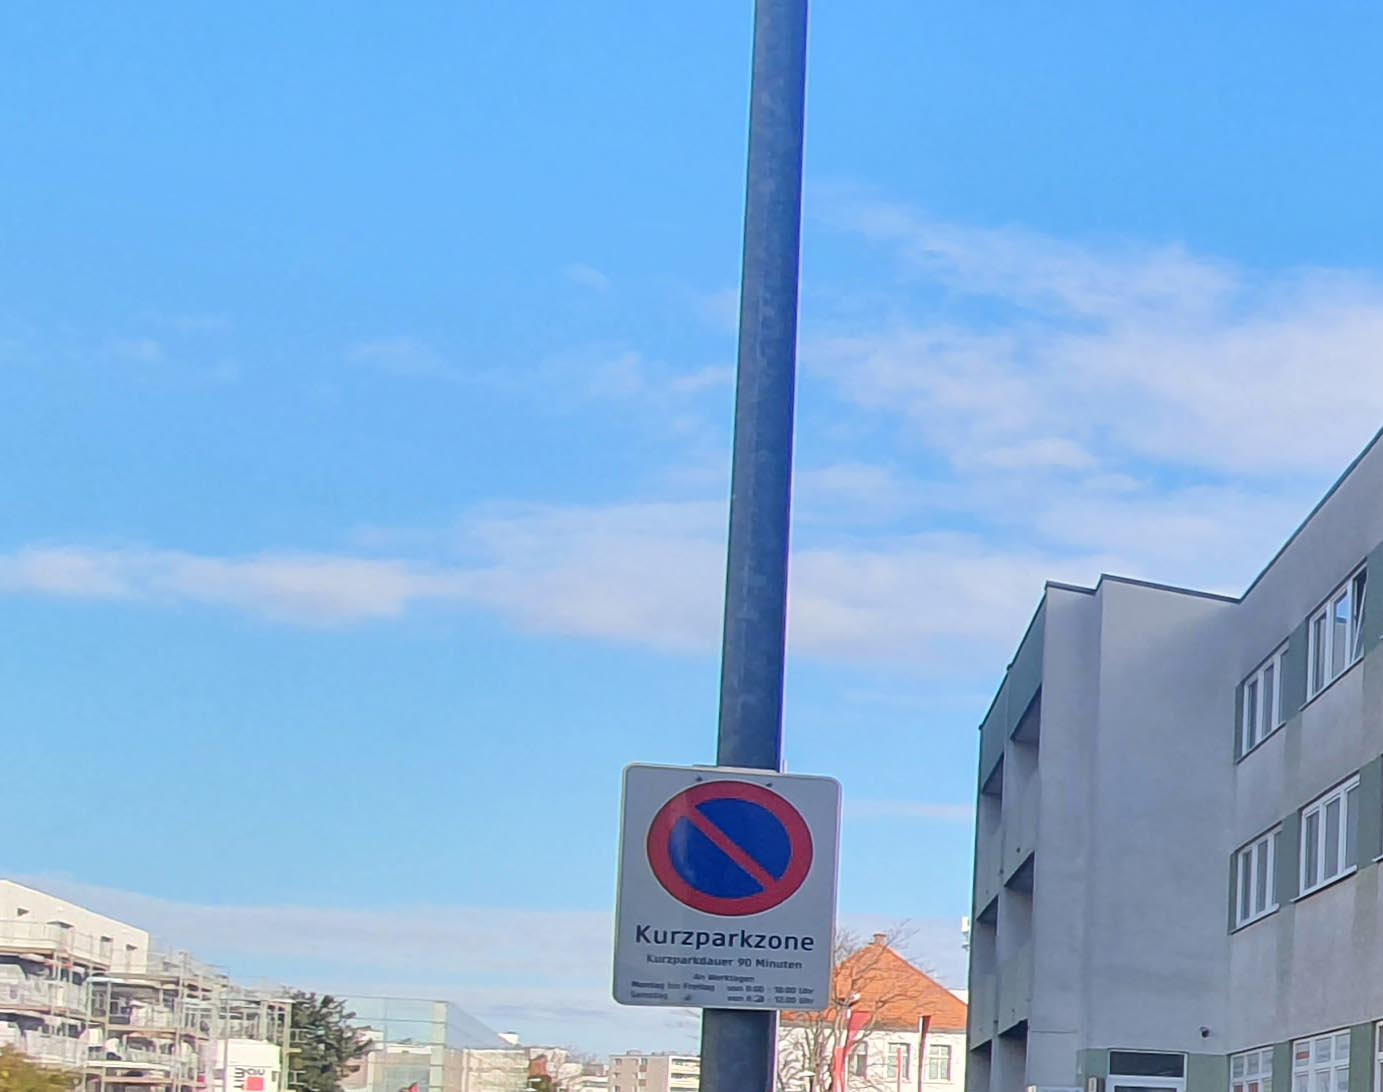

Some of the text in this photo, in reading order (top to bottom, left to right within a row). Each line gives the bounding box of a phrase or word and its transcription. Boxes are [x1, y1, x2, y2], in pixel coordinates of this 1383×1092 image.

[635, 925, 815, 951] Kurzparkzone
[646, 954, 803, 969] Kurzparkdauer 90 Minuten
